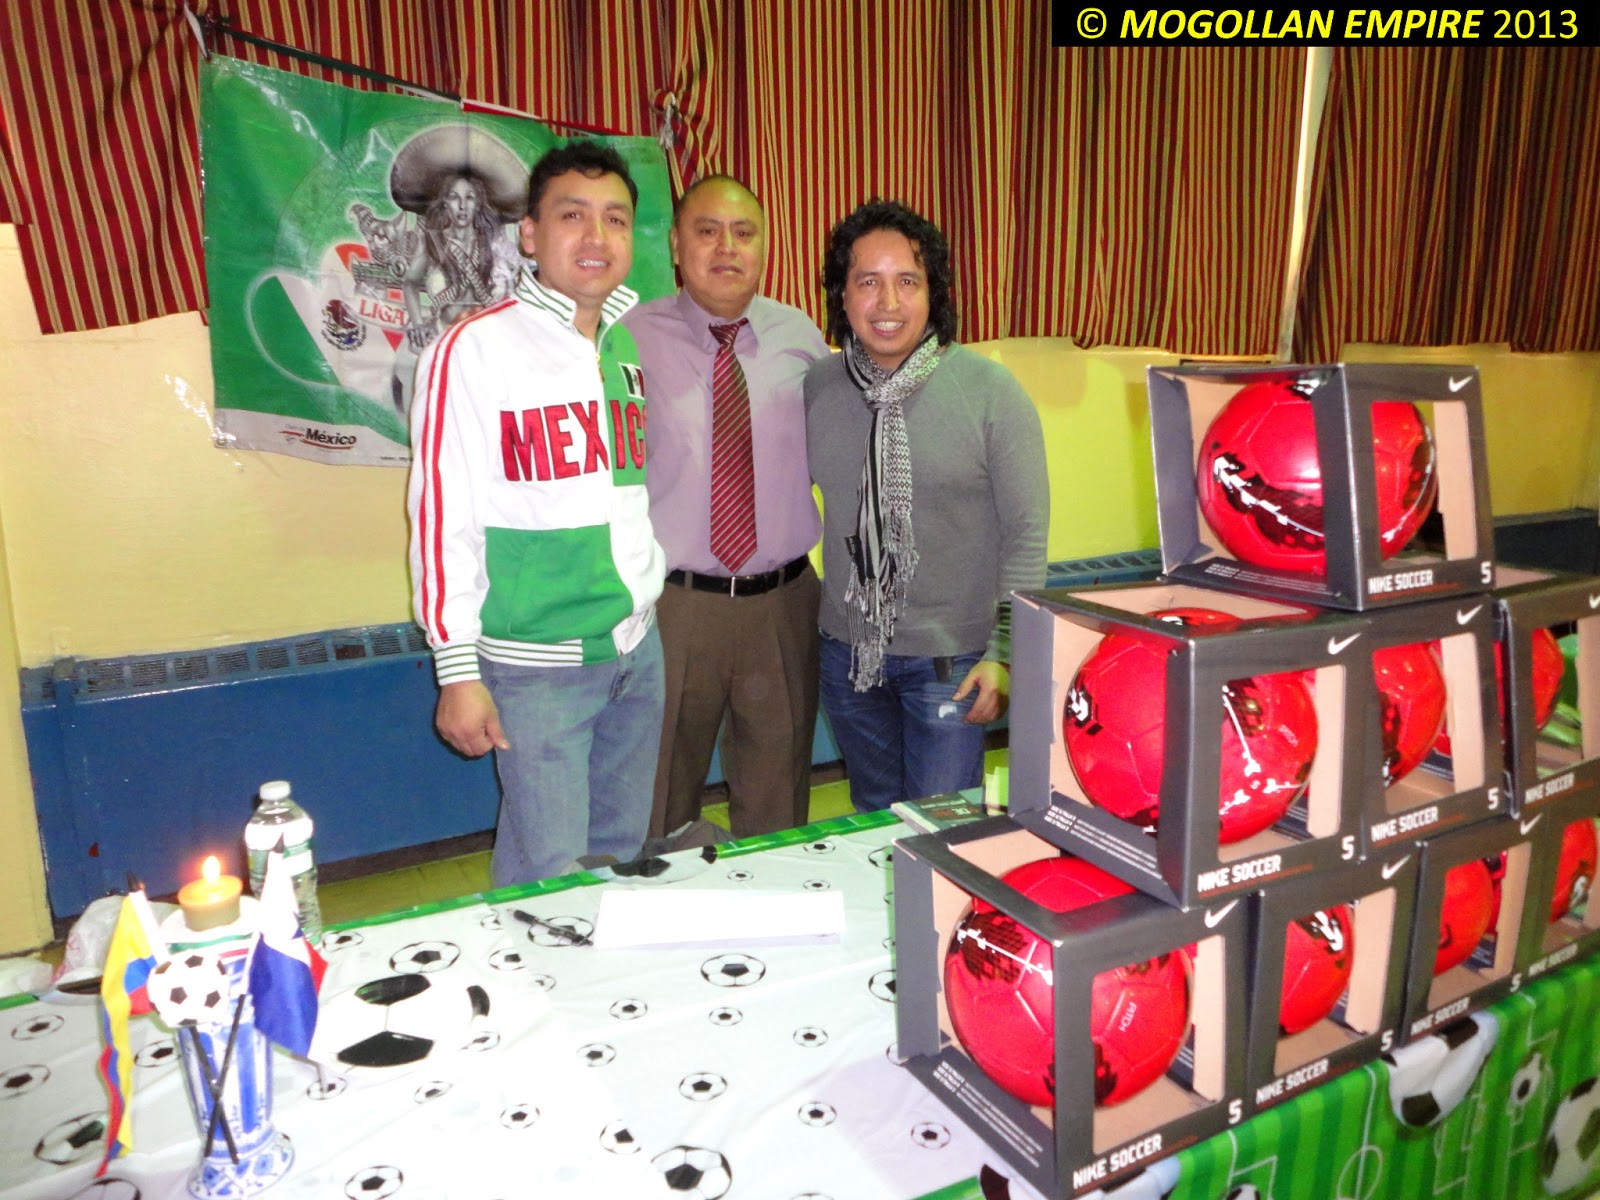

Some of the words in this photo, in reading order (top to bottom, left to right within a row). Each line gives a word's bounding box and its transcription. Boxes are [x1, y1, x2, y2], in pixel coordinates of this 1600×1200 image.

[359, 298, 406, 327] LIGA
[305, 427, 357, 445] México
[500, 399, 646, 482] MEXIC
[1368, 574, 1394, 594] NIKE
[1394, 569, 1434, 590] SOCCER
[1480, 561, 1492, 585] 5
[1487, 787, 1500, 810] 5
[1371, 818, 1398, 842] NIKE
[1398, 806, 1439, 833] SOCCER
[1341, 835, 1355, 861] 5
[1197, 867, 1230, 893] NIKE
[1231, 854, 1282, 884] SOCCER
[1510, 972, 1523, 993] 5
[1380, 1029, 1394, 1052] 5
[1256, 1078, 1285, 1105] NIKE
[1285, 1058, 1330, 1091] SOCCER
[1228, 1098, 1243, 1125] 5
[1072, 1158, 1108, 1190] NIKE
[1109, 1133, 1163, 1173] SOCCER
